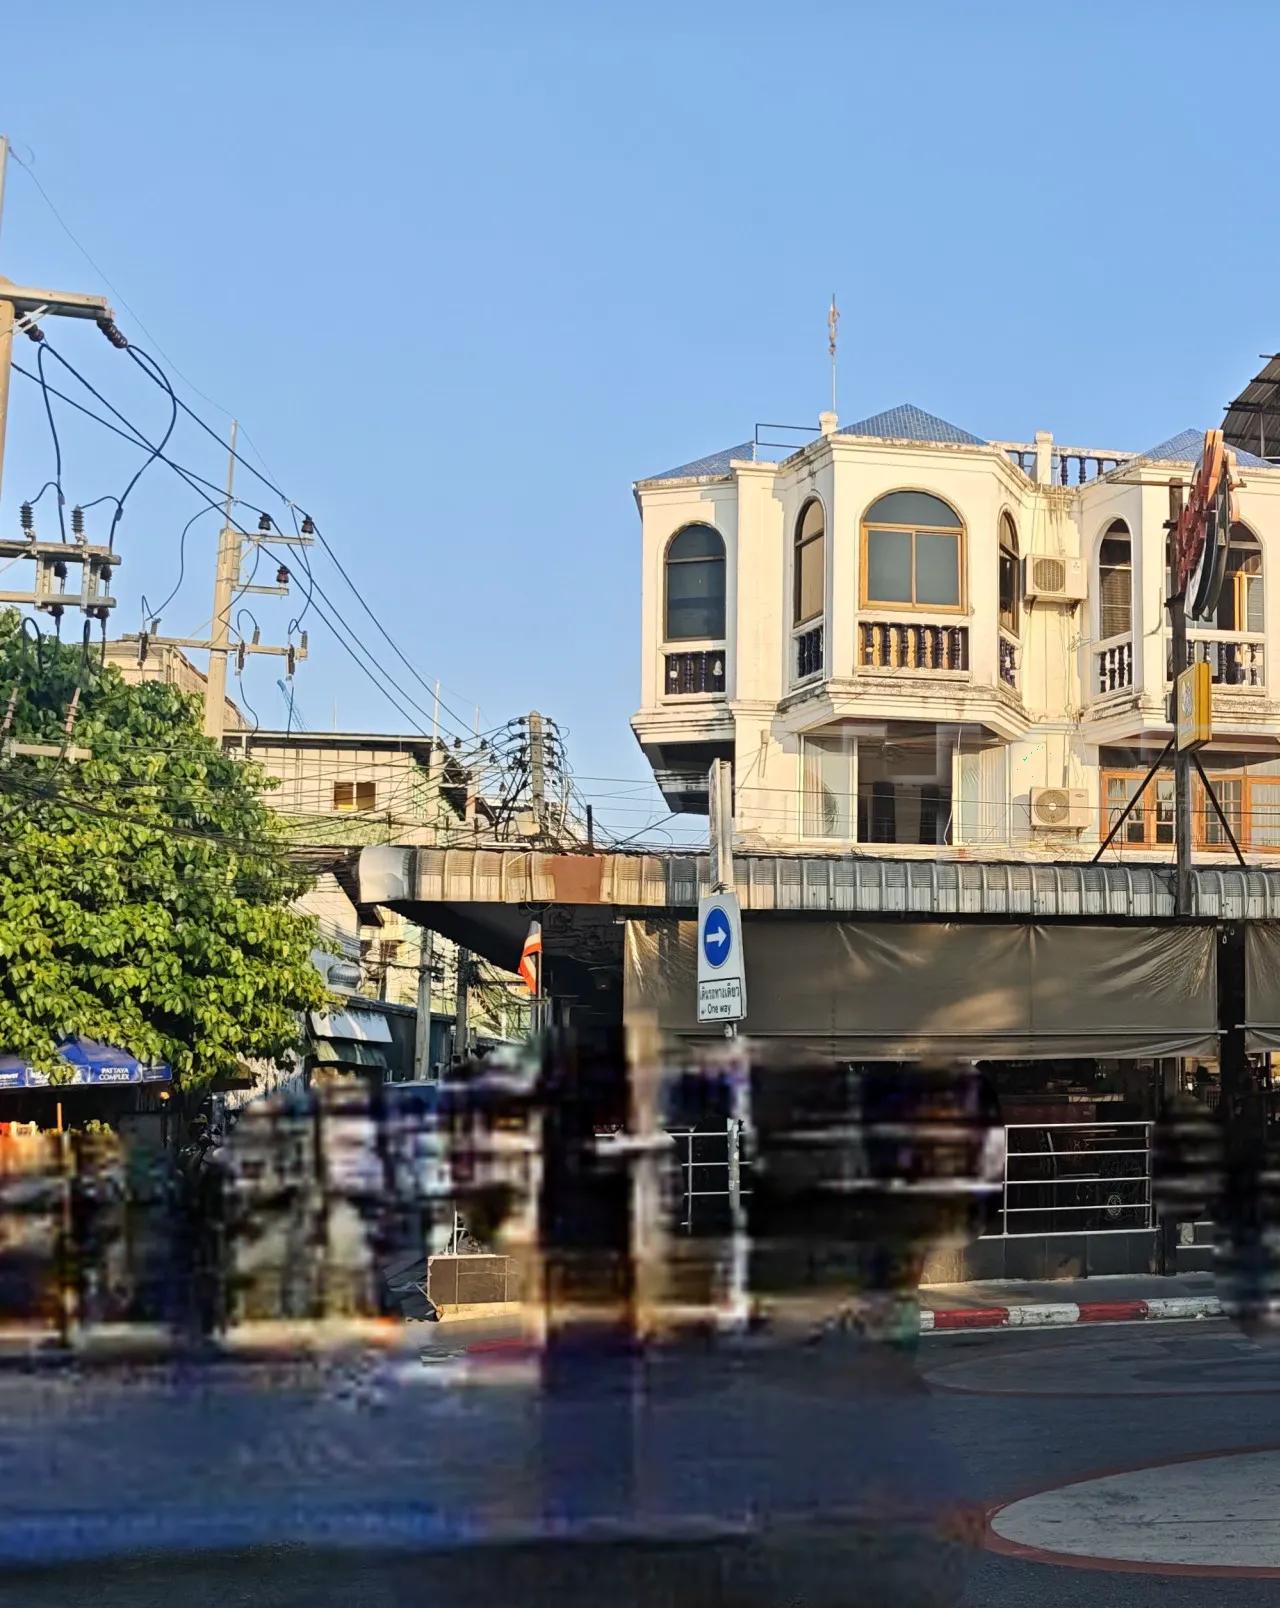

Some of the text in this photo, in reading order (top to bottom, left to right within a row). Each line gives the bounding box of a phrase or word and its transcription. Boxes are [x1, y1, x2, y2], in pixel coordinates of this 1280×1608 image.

[707, 1003, 732, 1016] One way
[98, 1073, 130, 1081] COMPLEX
